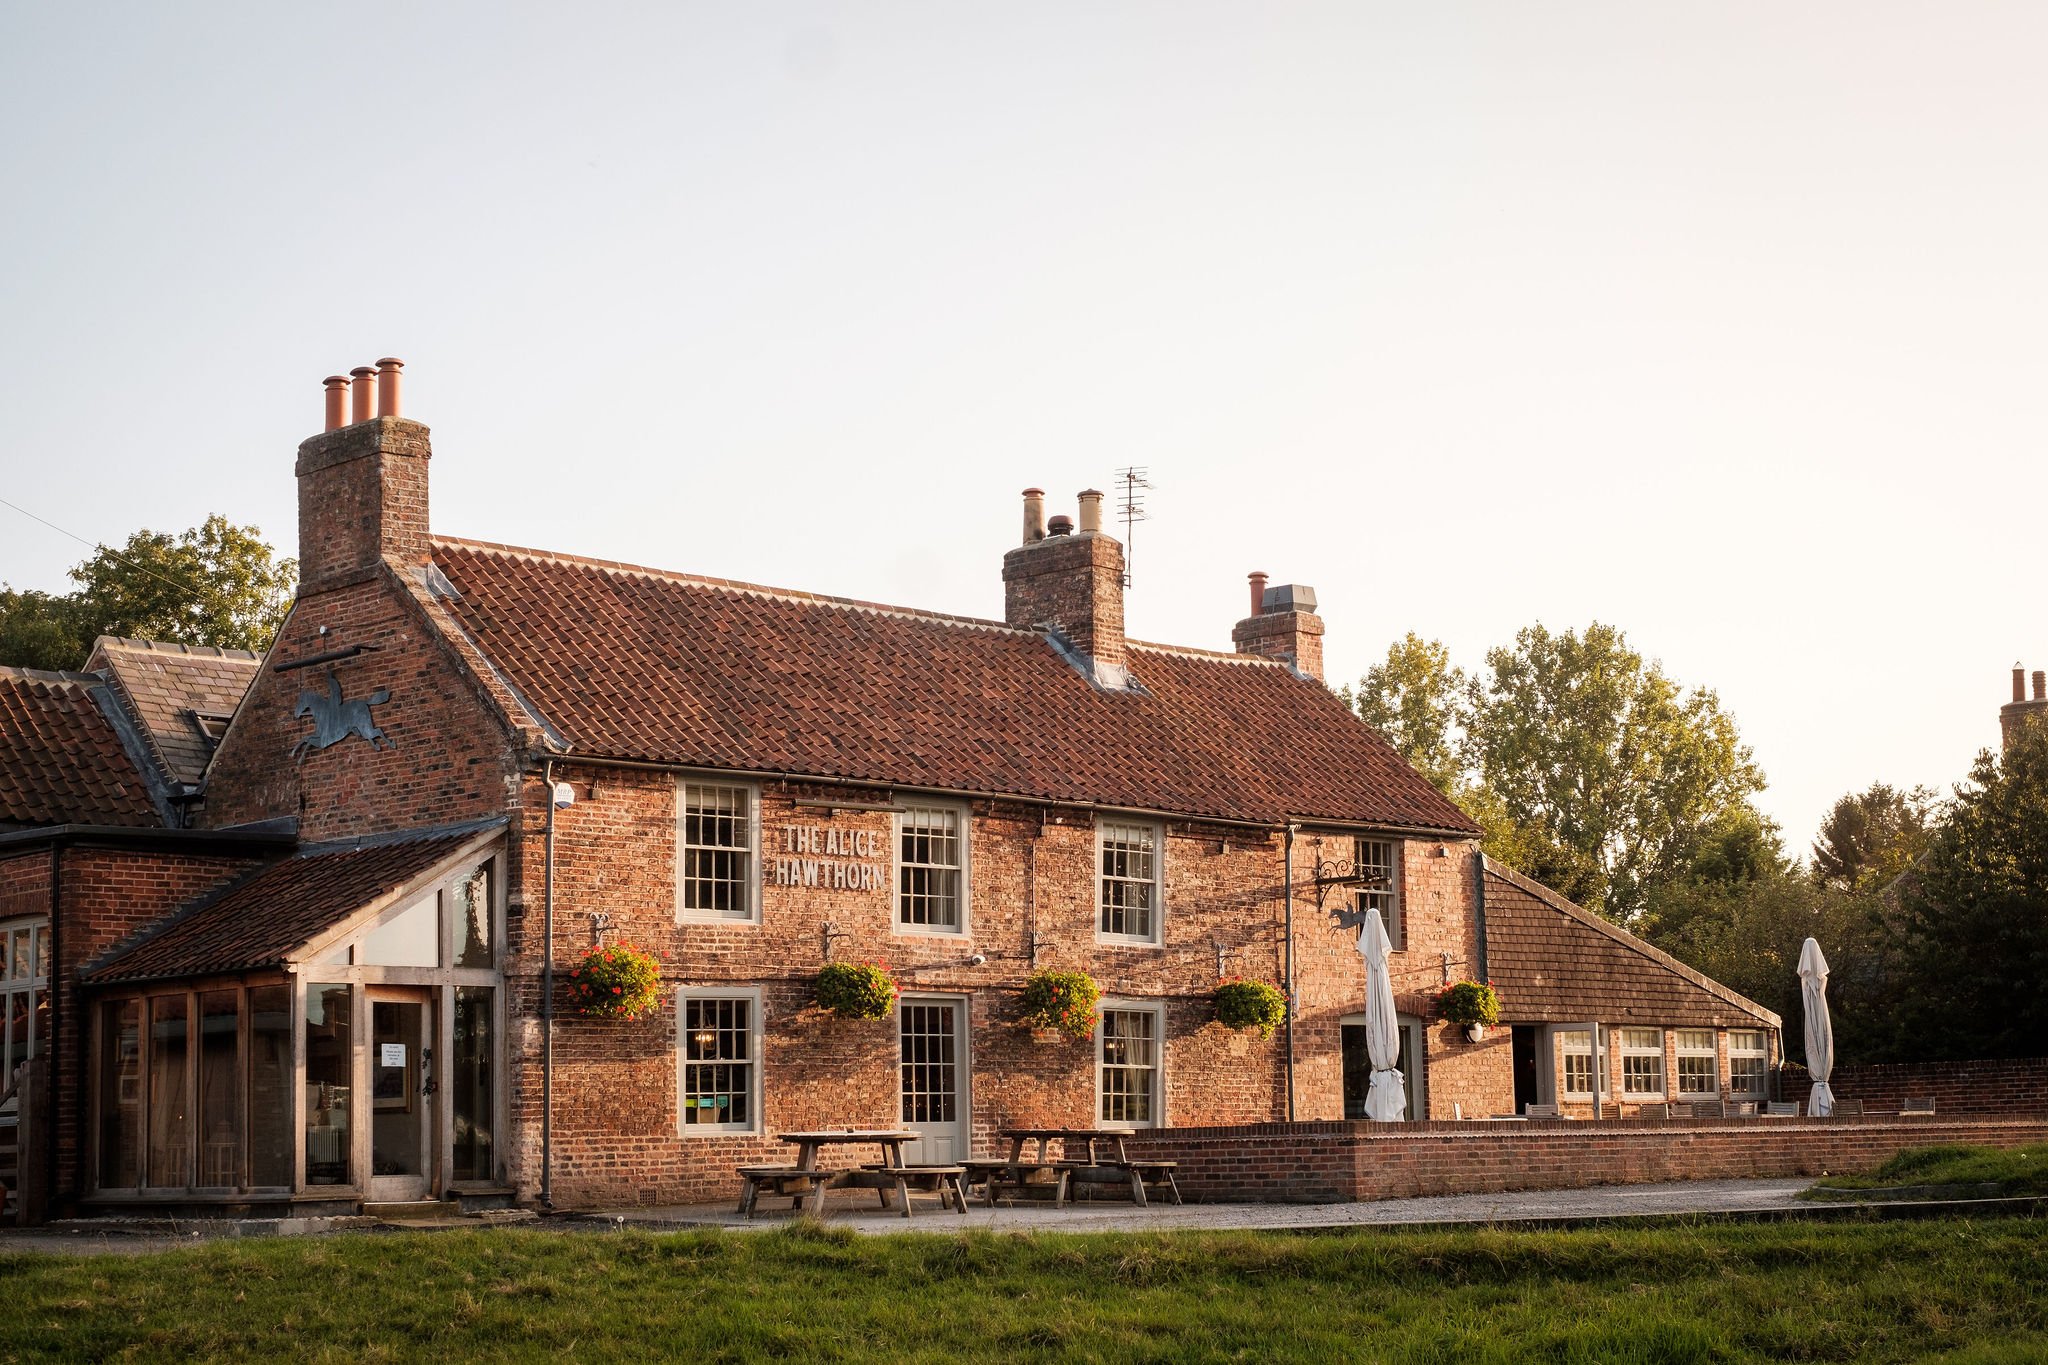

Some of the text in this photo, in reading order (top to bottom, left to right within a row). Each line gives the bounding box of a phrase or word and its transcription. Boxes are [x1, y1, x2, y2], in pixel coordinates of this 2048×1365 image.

[784, 825, 880, 857] THE ALICE
[776, 857, 886, 889] HAWTHORN
